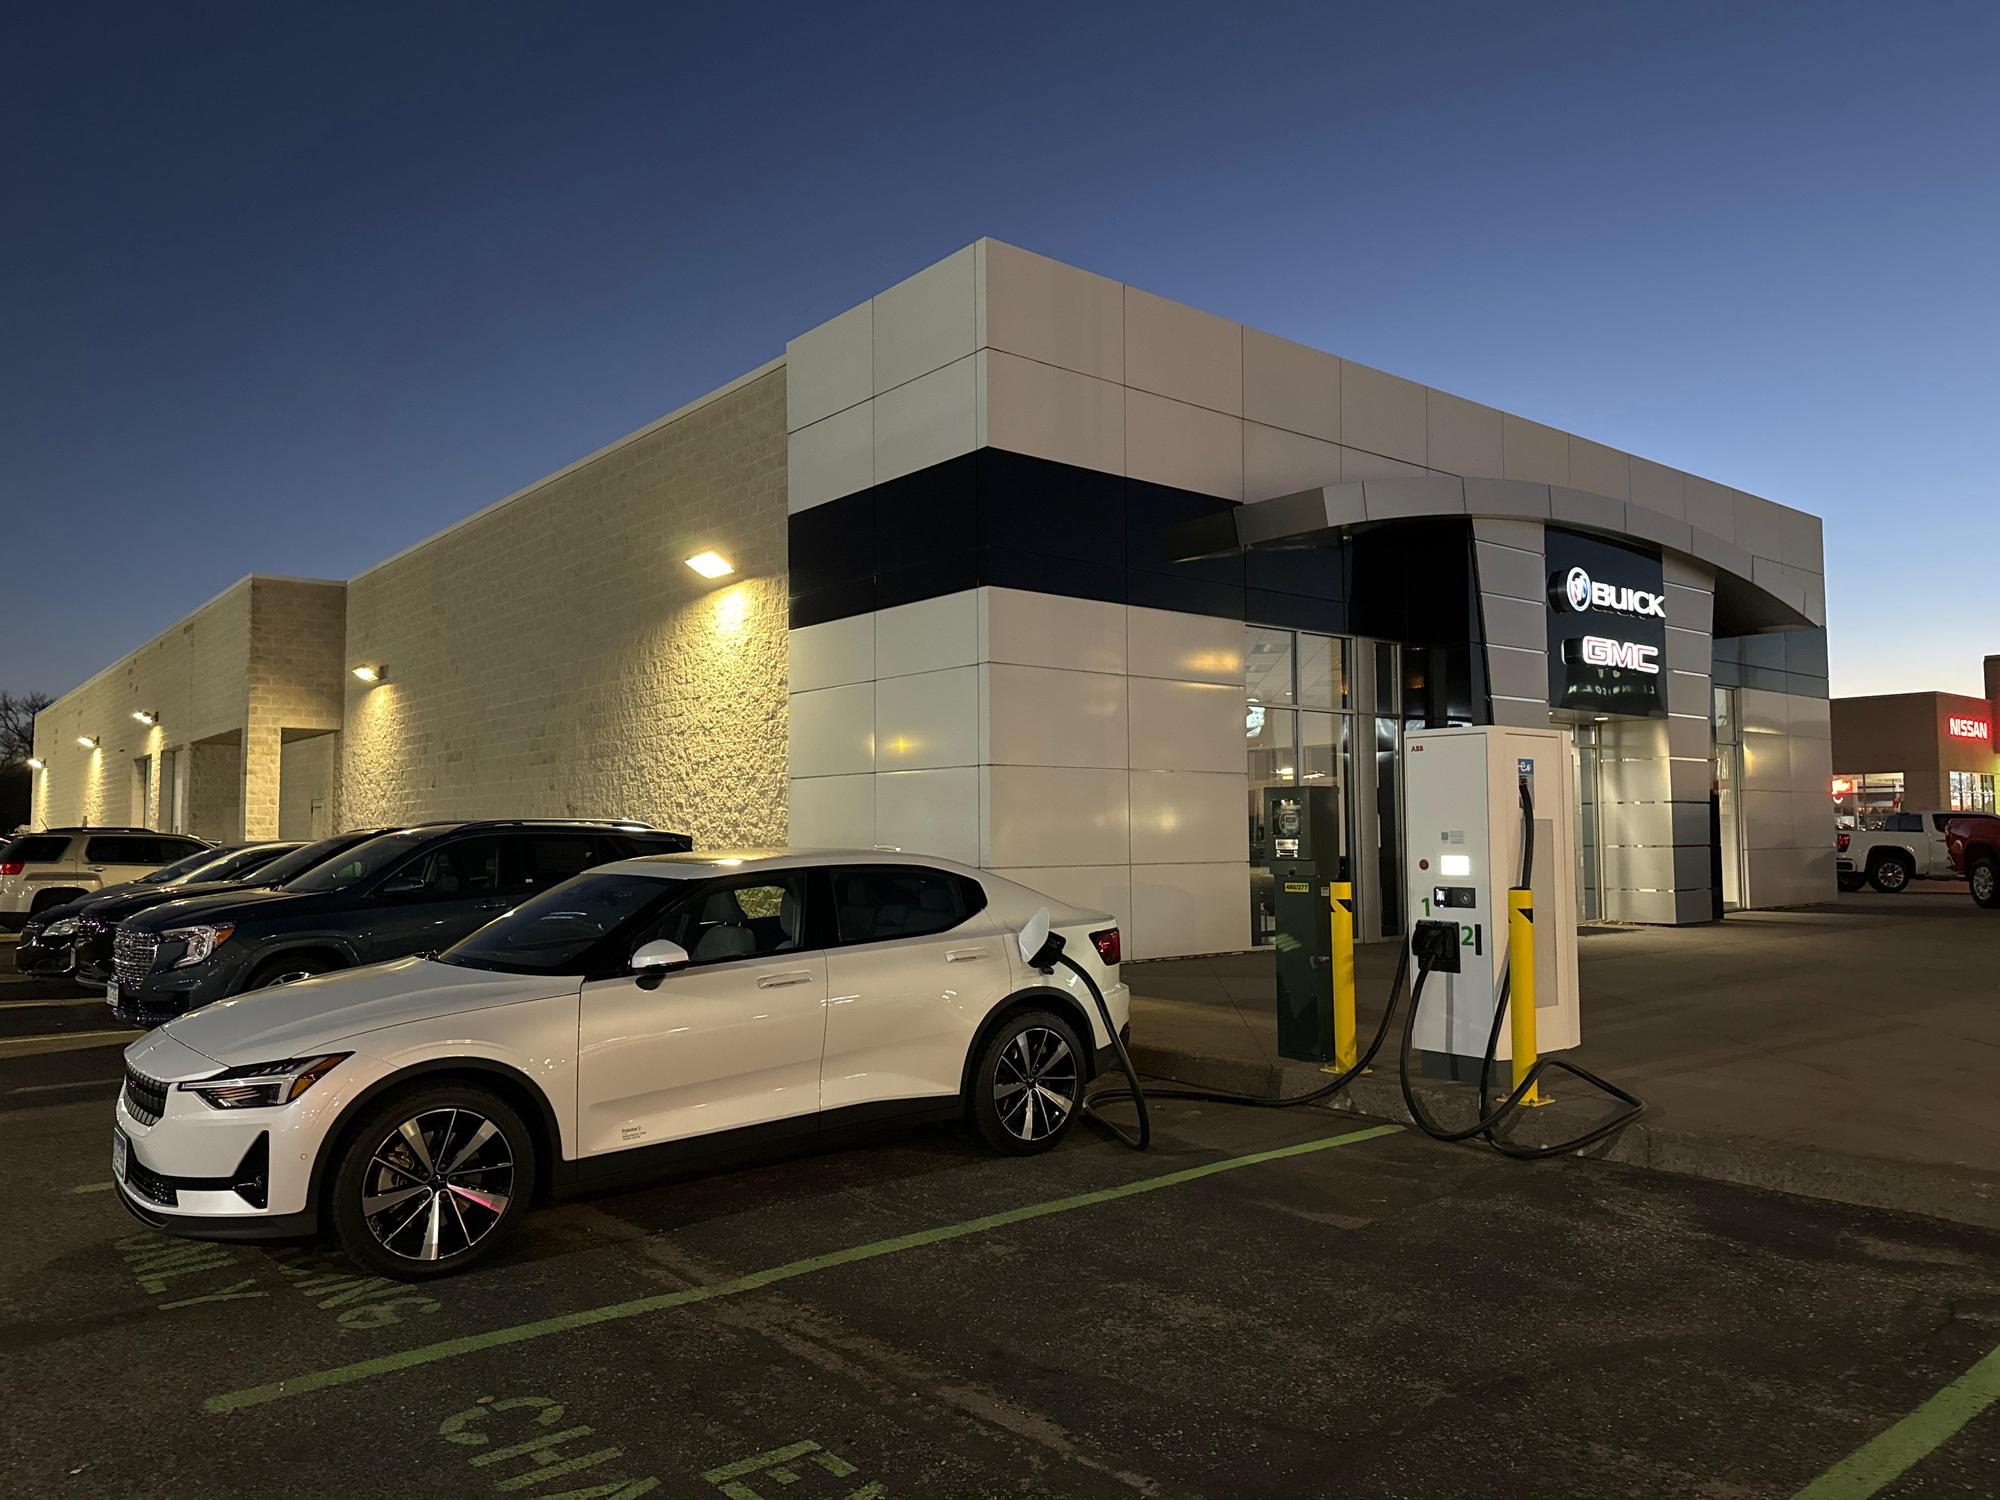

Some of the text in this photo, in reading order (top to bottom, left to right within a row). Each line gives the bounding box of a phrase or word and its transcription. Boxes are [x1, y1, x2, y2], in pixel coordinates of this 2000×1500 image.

[1592, 581, 1666, 618] BUICK
[1583, 635, 1660, 674] GMC
[1949, 717, 1988, 739] NISSAN
[1421, 897, 1430, 917] 1
[1461, 926, 1474, 946] 2
